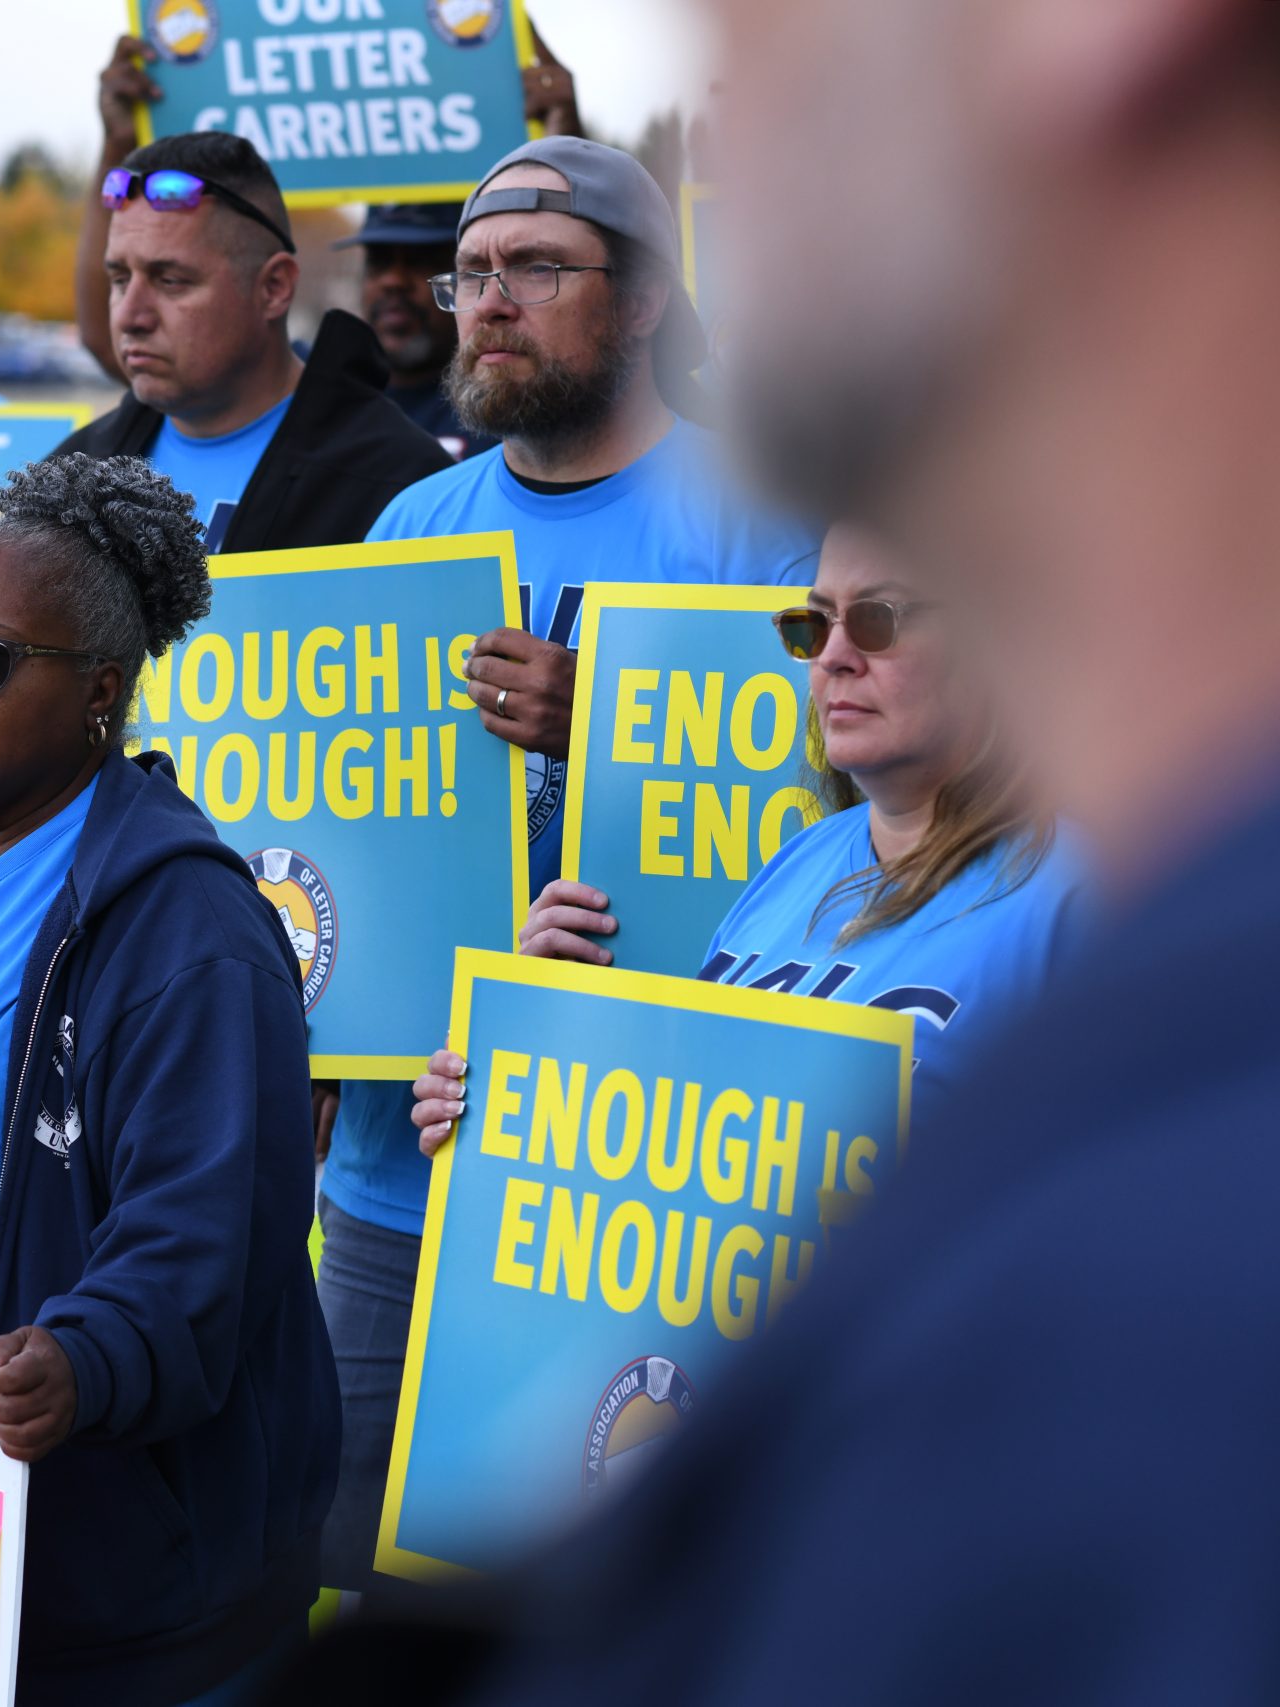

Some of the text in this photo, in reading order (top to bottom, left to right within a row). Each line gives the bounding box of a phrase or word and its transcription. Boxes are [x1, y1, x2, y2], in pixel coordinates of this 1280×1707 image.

[223, 28, 431, 97] LETTER
[125, 622, 477, 725] NOUGH IS
[612, 668, 828, 773] ENO
[124, 723, 458, 823] NOUGH!
[528, 787, 559, 837] CARRI
[300, 868, 333, 1006] OF LETTER CARRIE
[480, 1049, 805, 1217] ENOUGH
[588, 1370, 639, 1472] ASSOCIATION
